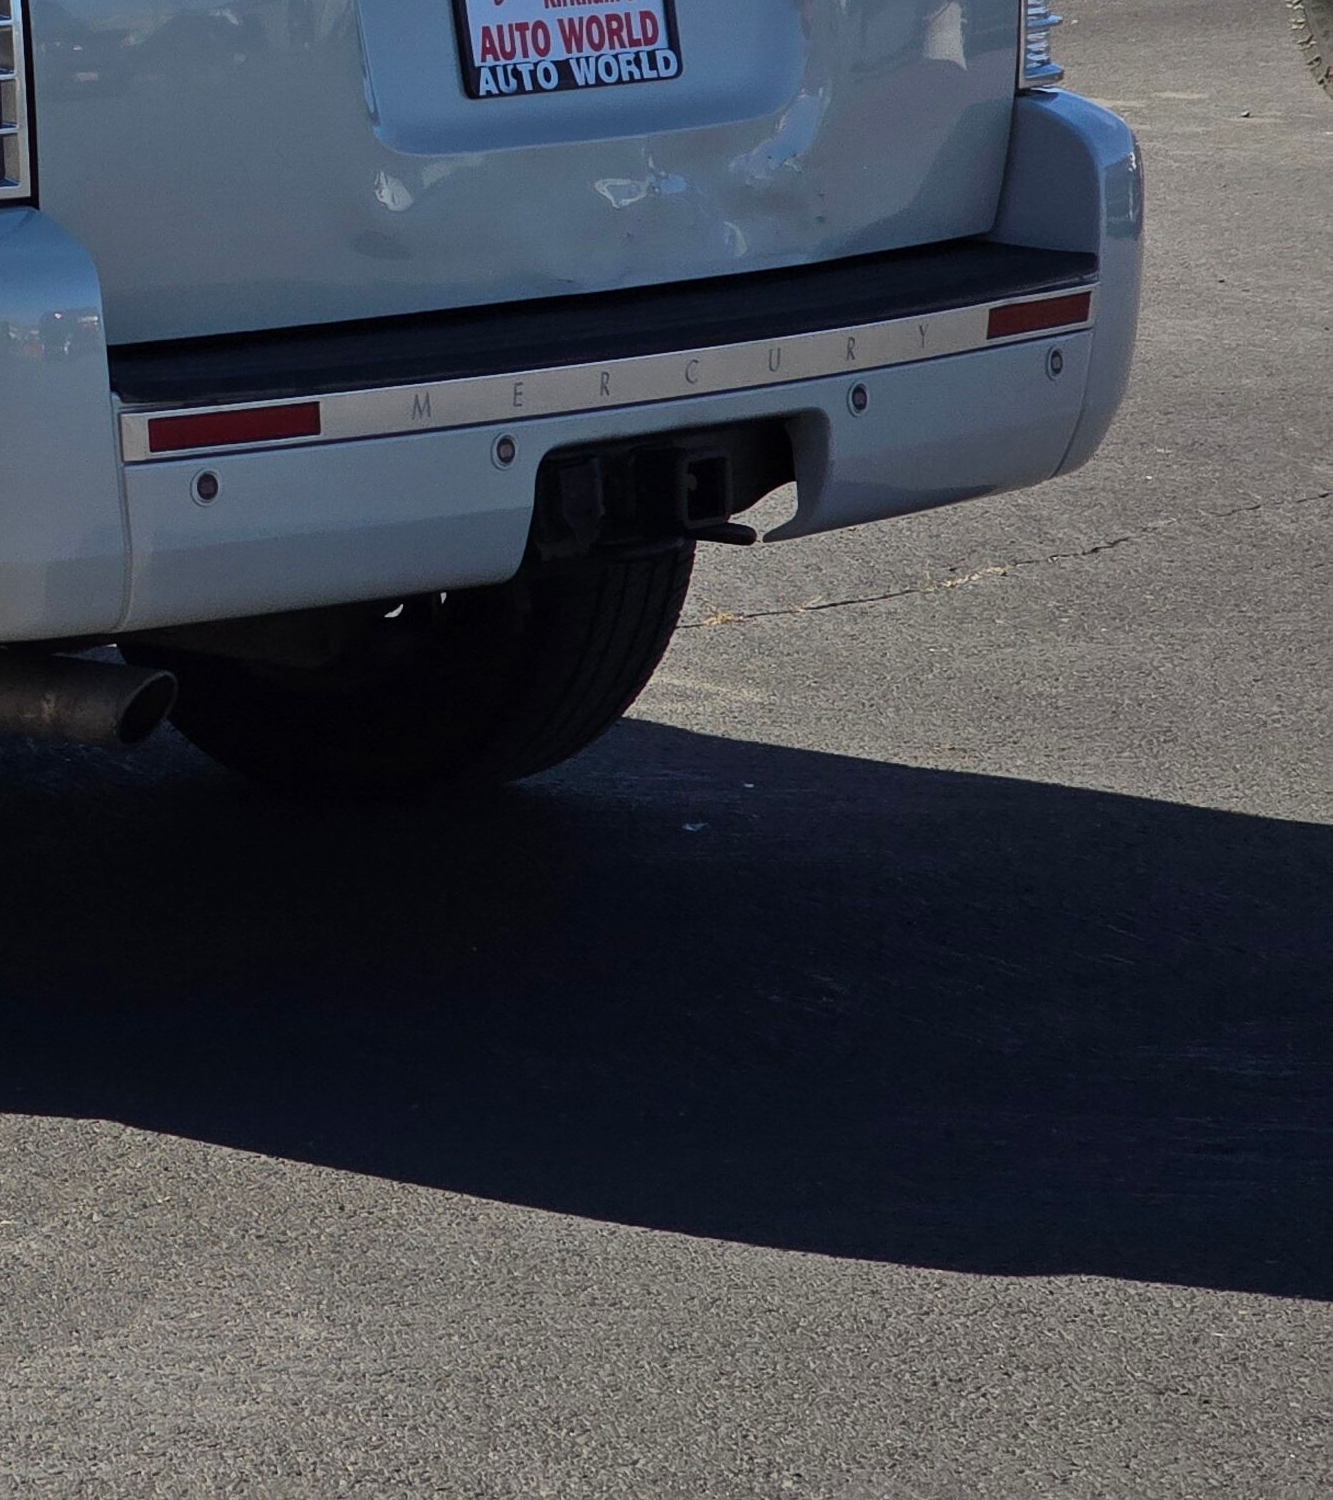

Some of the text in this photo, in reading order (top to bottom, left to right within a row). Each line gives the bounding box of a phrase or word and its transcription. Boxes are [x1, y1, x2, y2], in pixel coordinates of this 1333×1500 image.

[480, 11, 659, 63] AUTO WORLD
[478, 48, 678, 96] AUTO WORLD
[411, 323, 929, 420] MERCURY
